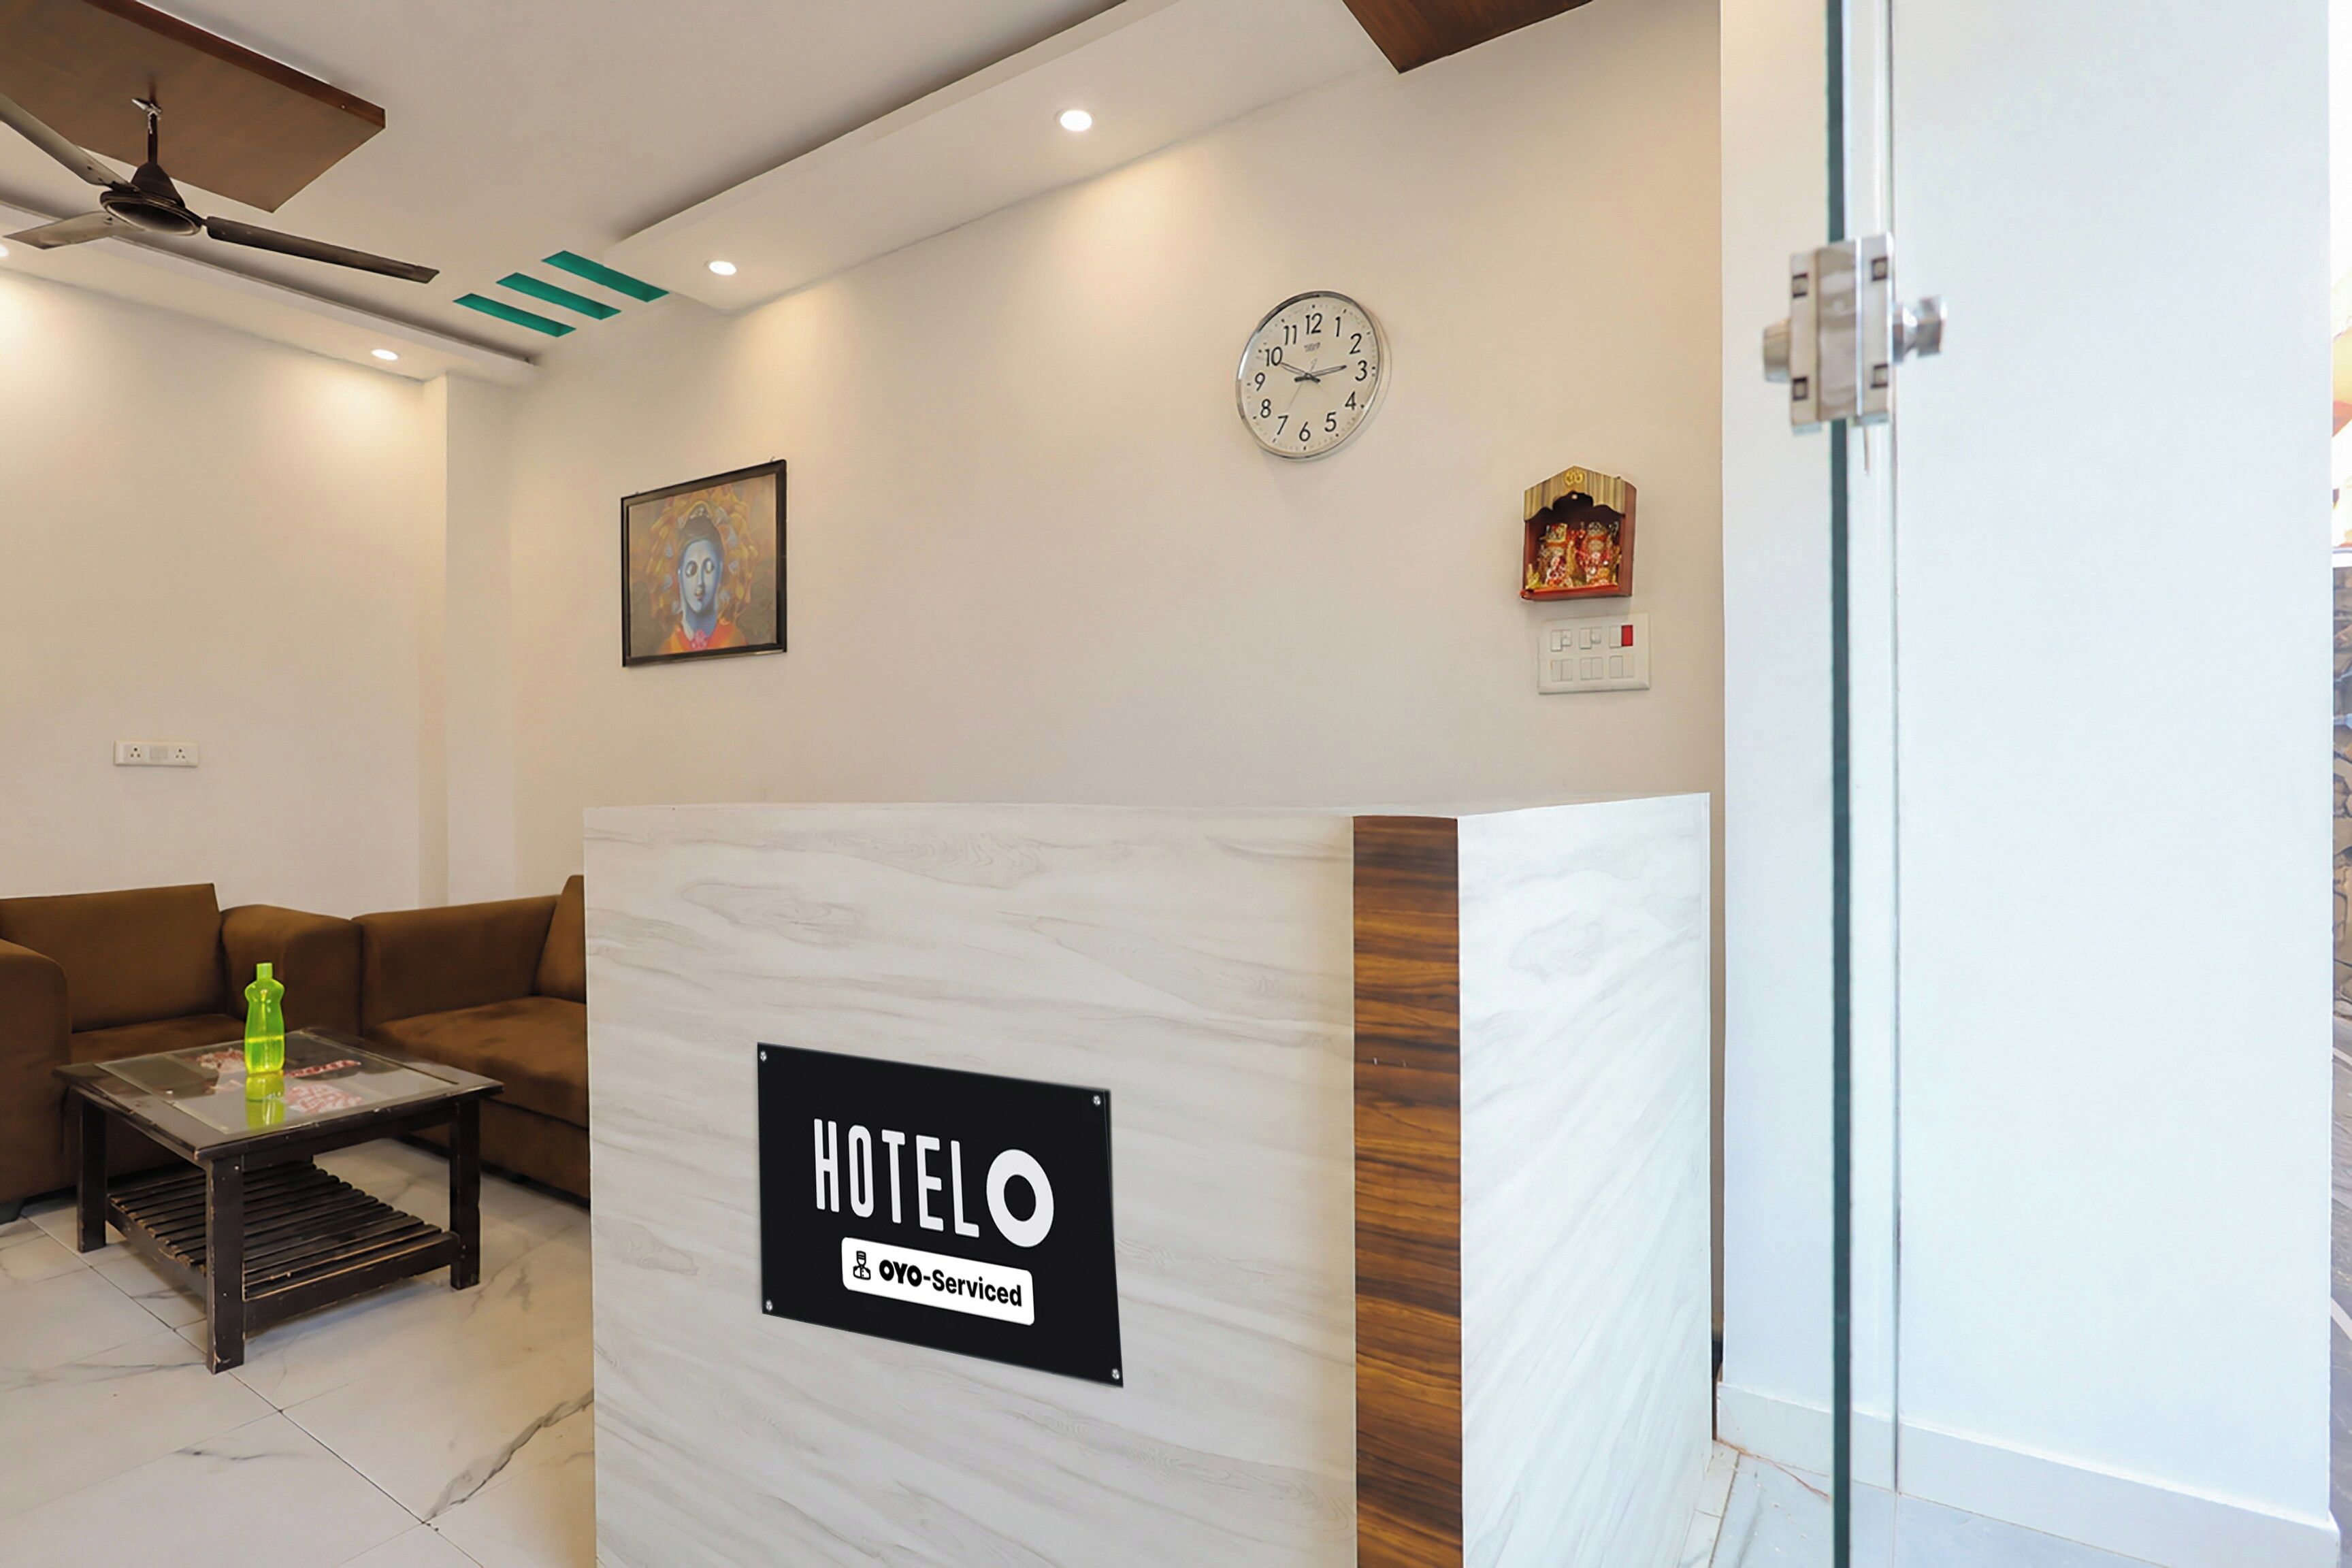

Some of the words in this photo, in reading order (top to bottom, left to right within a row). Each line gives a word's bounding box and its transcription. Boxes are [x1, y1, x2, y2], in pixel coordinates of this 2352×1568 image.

[1305, 313, 1322, 334] 12
[1335, 316, 1341, 337] 1
[1284, 325, 1297, 345] 11
[1349, 333, 1362, 354] 2
[1265, 346, 1283, 366] 10
[1355, 360, 1367, 381] 3
[1255, 372, 1265, 391] 9
[1260, 399, 1271, 418] 8
[1345, 391, 1357, 410] 4
[1277, 414, 1289, 435] 7
[1299, 421, 1311, 441] 6
[1324, 412, 1337, 431] 5
[879, 1259, 1022, 1307] OYO-Serviced
